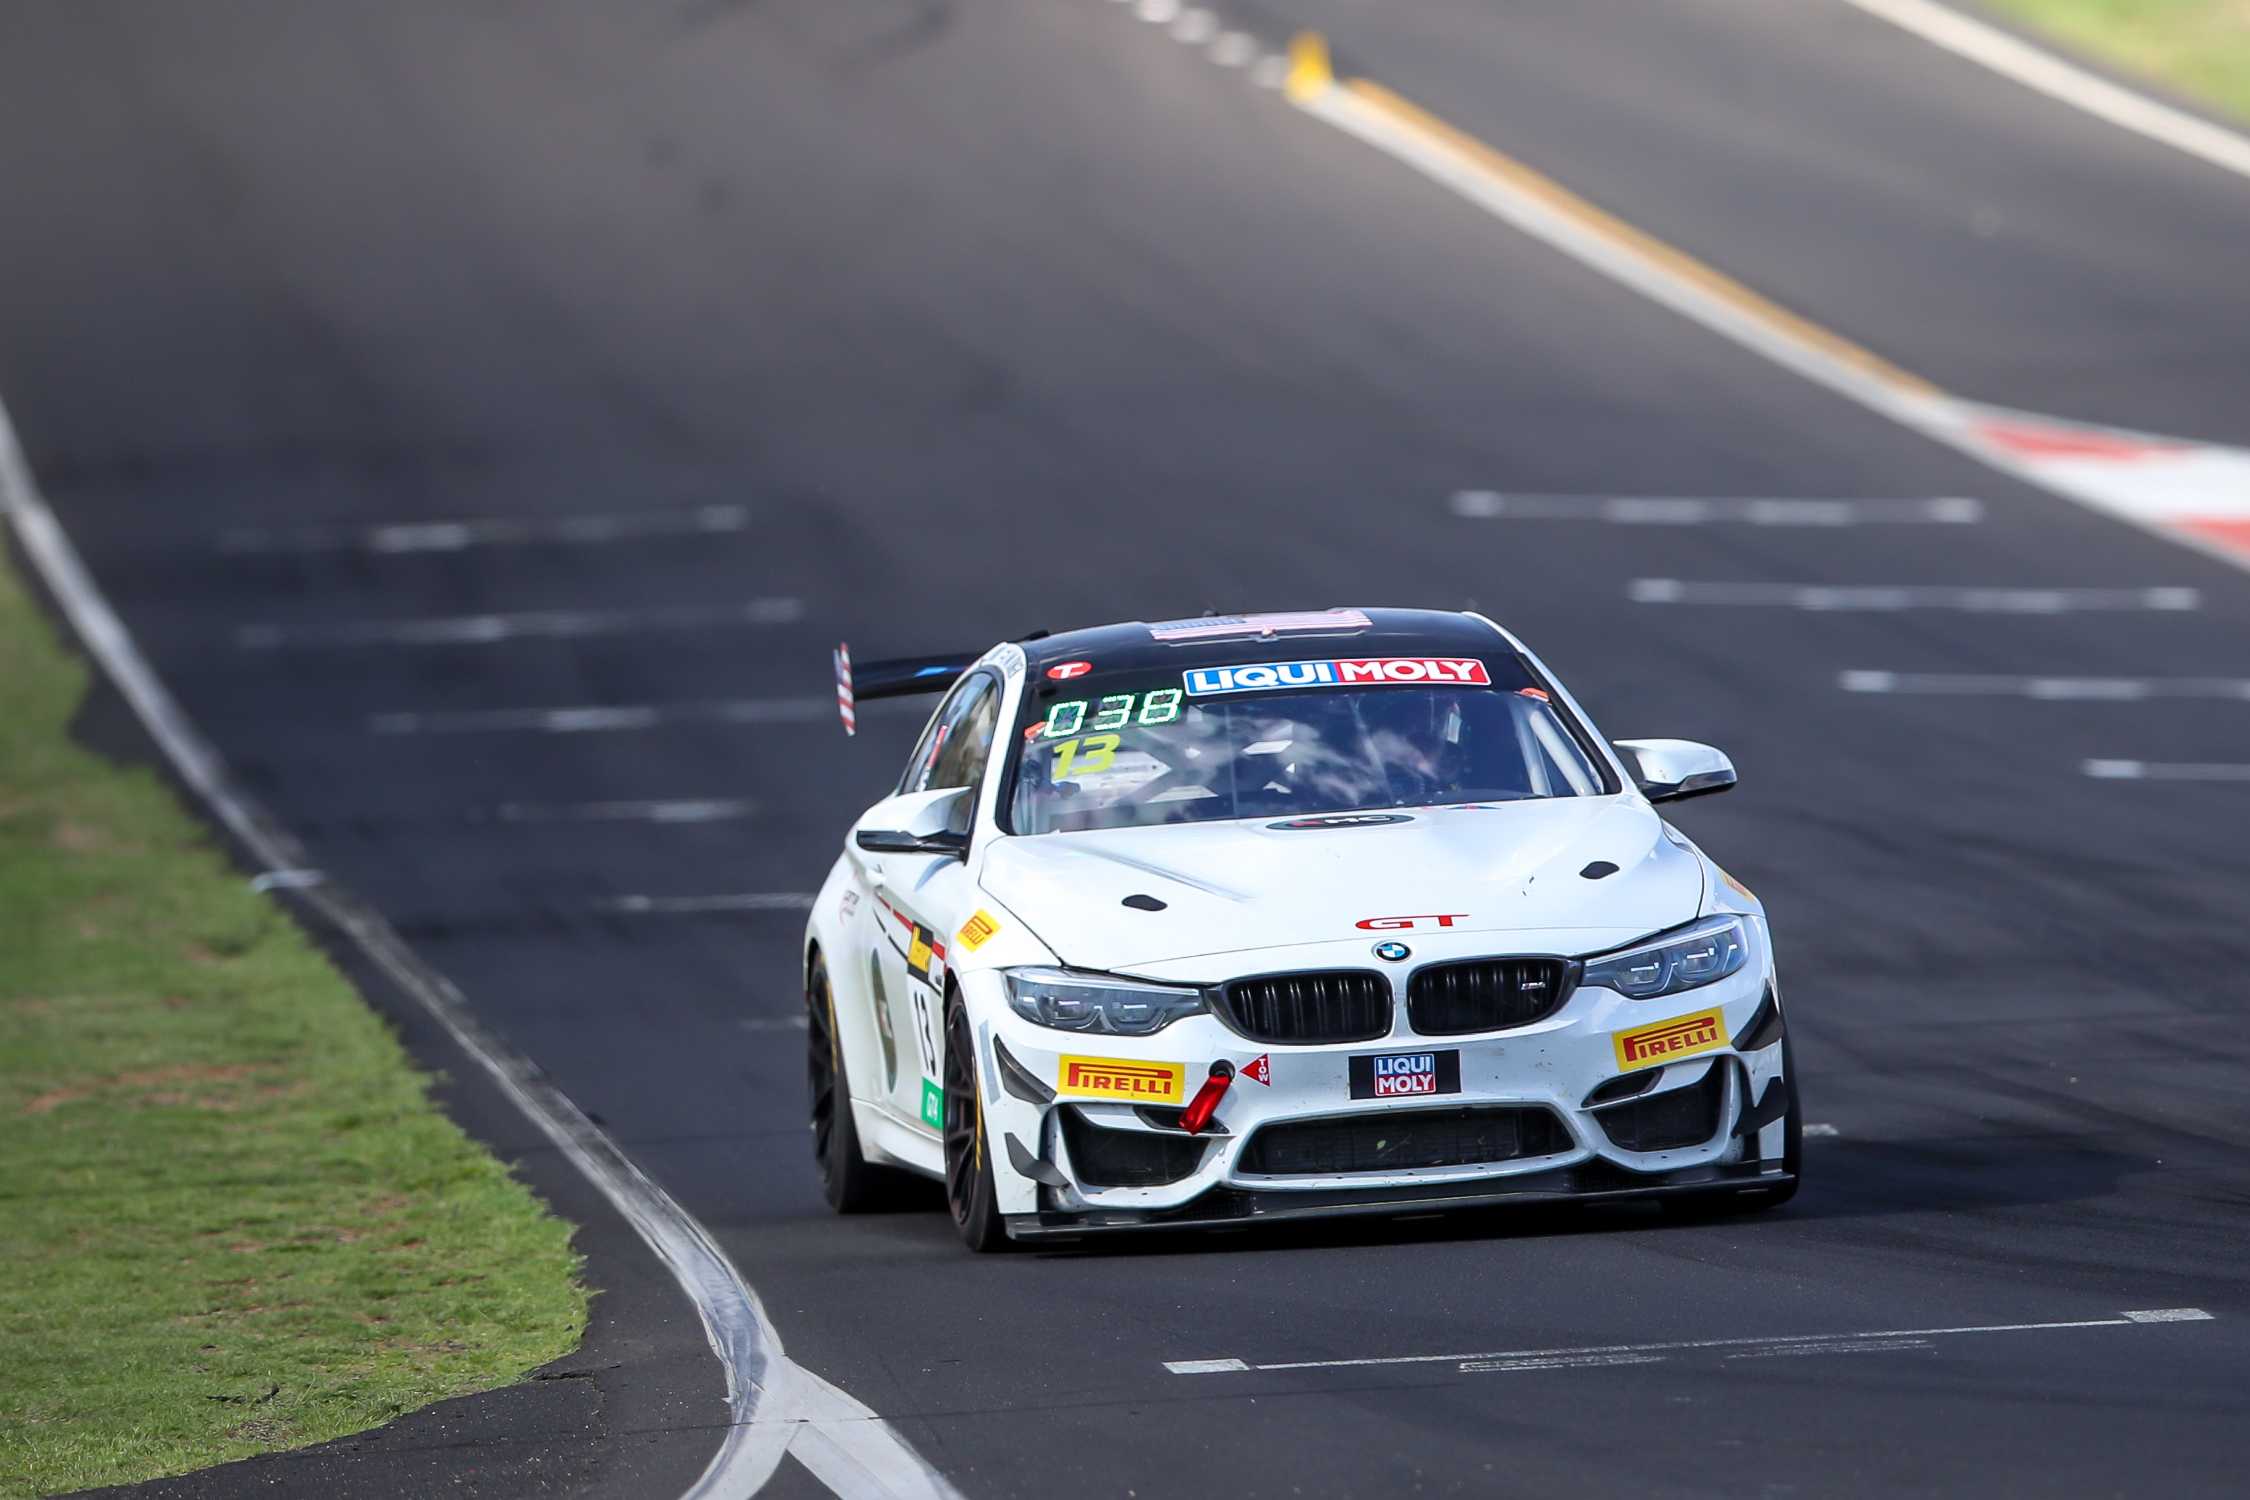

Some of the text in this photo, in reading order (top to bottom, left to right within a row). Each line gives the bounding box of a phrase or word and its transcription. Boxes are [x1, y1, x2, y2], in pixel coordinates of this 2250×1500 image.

[1194, 660, 1477, 692] LIQUI MOLY
[1044, 689, 1182, 737] 038
[1054, 734, 1121, 780] 13
[1355, 914, 1469, 930] GT
[913, 990, 936, 1077] 13
[1622, 1016, 1718, 1062] PIRELLI
[1068, 1062, 1174, 1095] PIRELLI
[1258, 1058, 1268, 1082] TOW
[1377, 1056, 1431, 1075] LIQUI
[1378, 1074, 1433, 1093] MOLY
